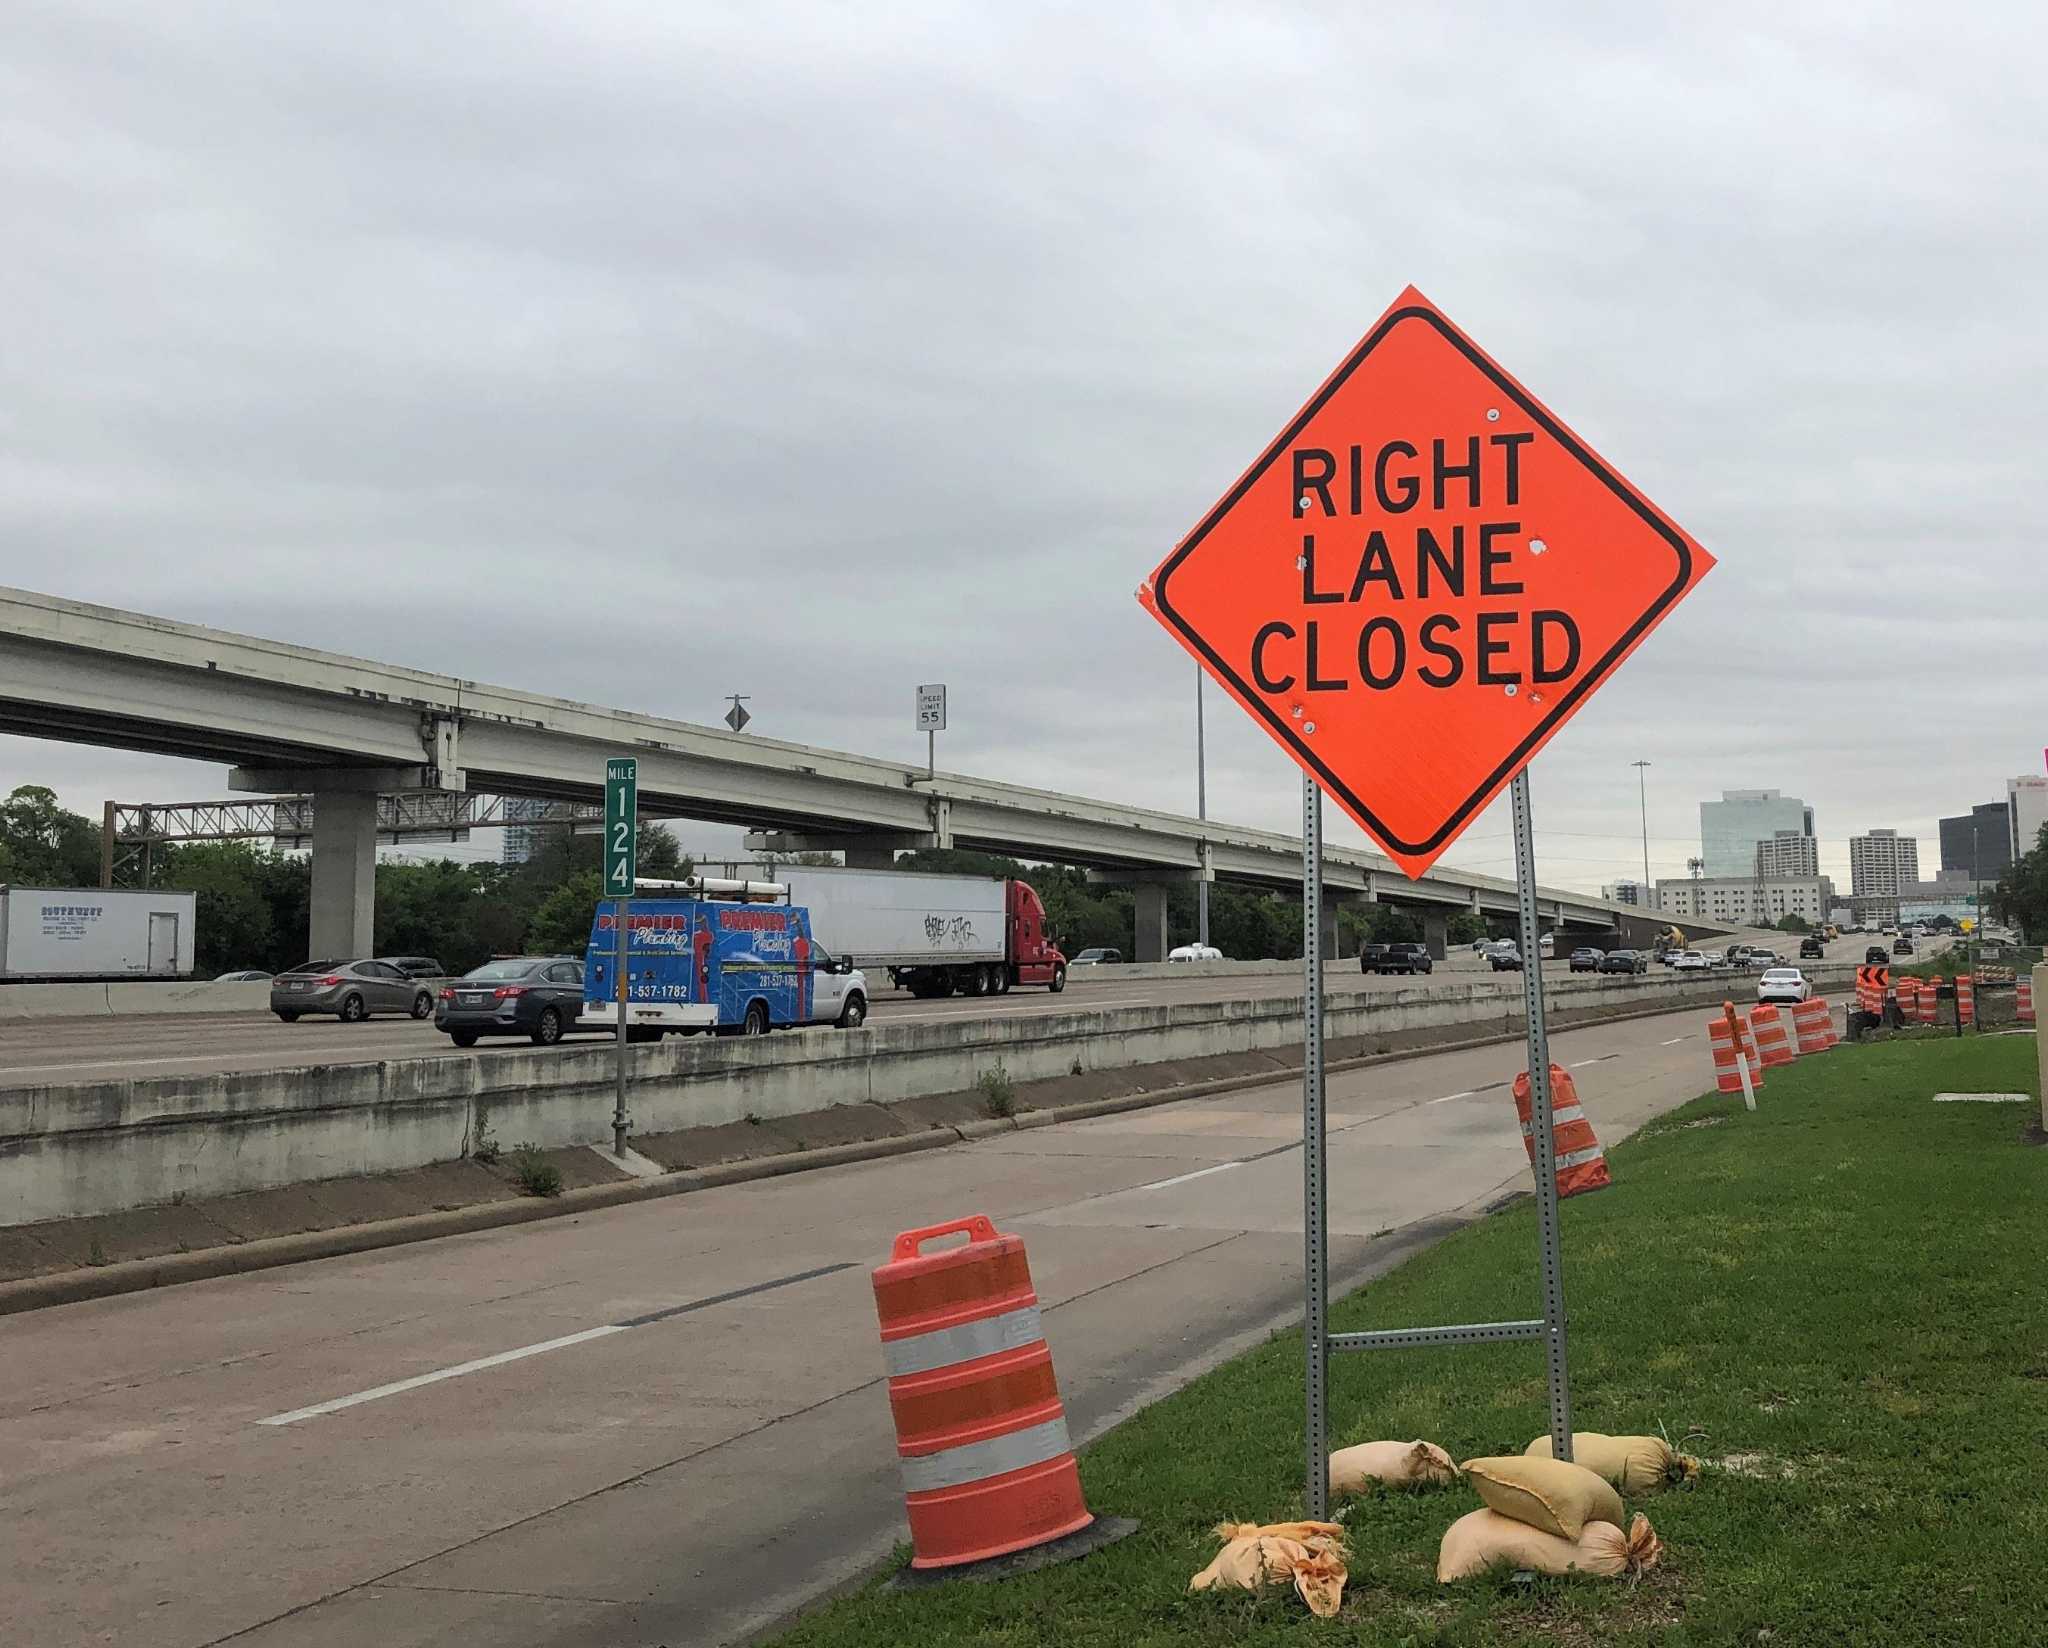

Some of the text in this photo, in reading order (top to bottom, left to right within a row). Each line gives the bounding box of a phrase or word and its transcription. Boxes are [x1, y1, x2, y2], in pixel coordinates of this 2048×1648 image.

[1292, 432, 1535, 520] RIGHT
[1302, 521, 1524, 604] LANE
[1251, 609, 1582, 695] CLOSED
[921, 711, 939, 723] 55
[608, 766, 635, 780] MILE
[633, 926, 688, 951] Plumbing
[615, 985, 687, 997] 1-537-1782
